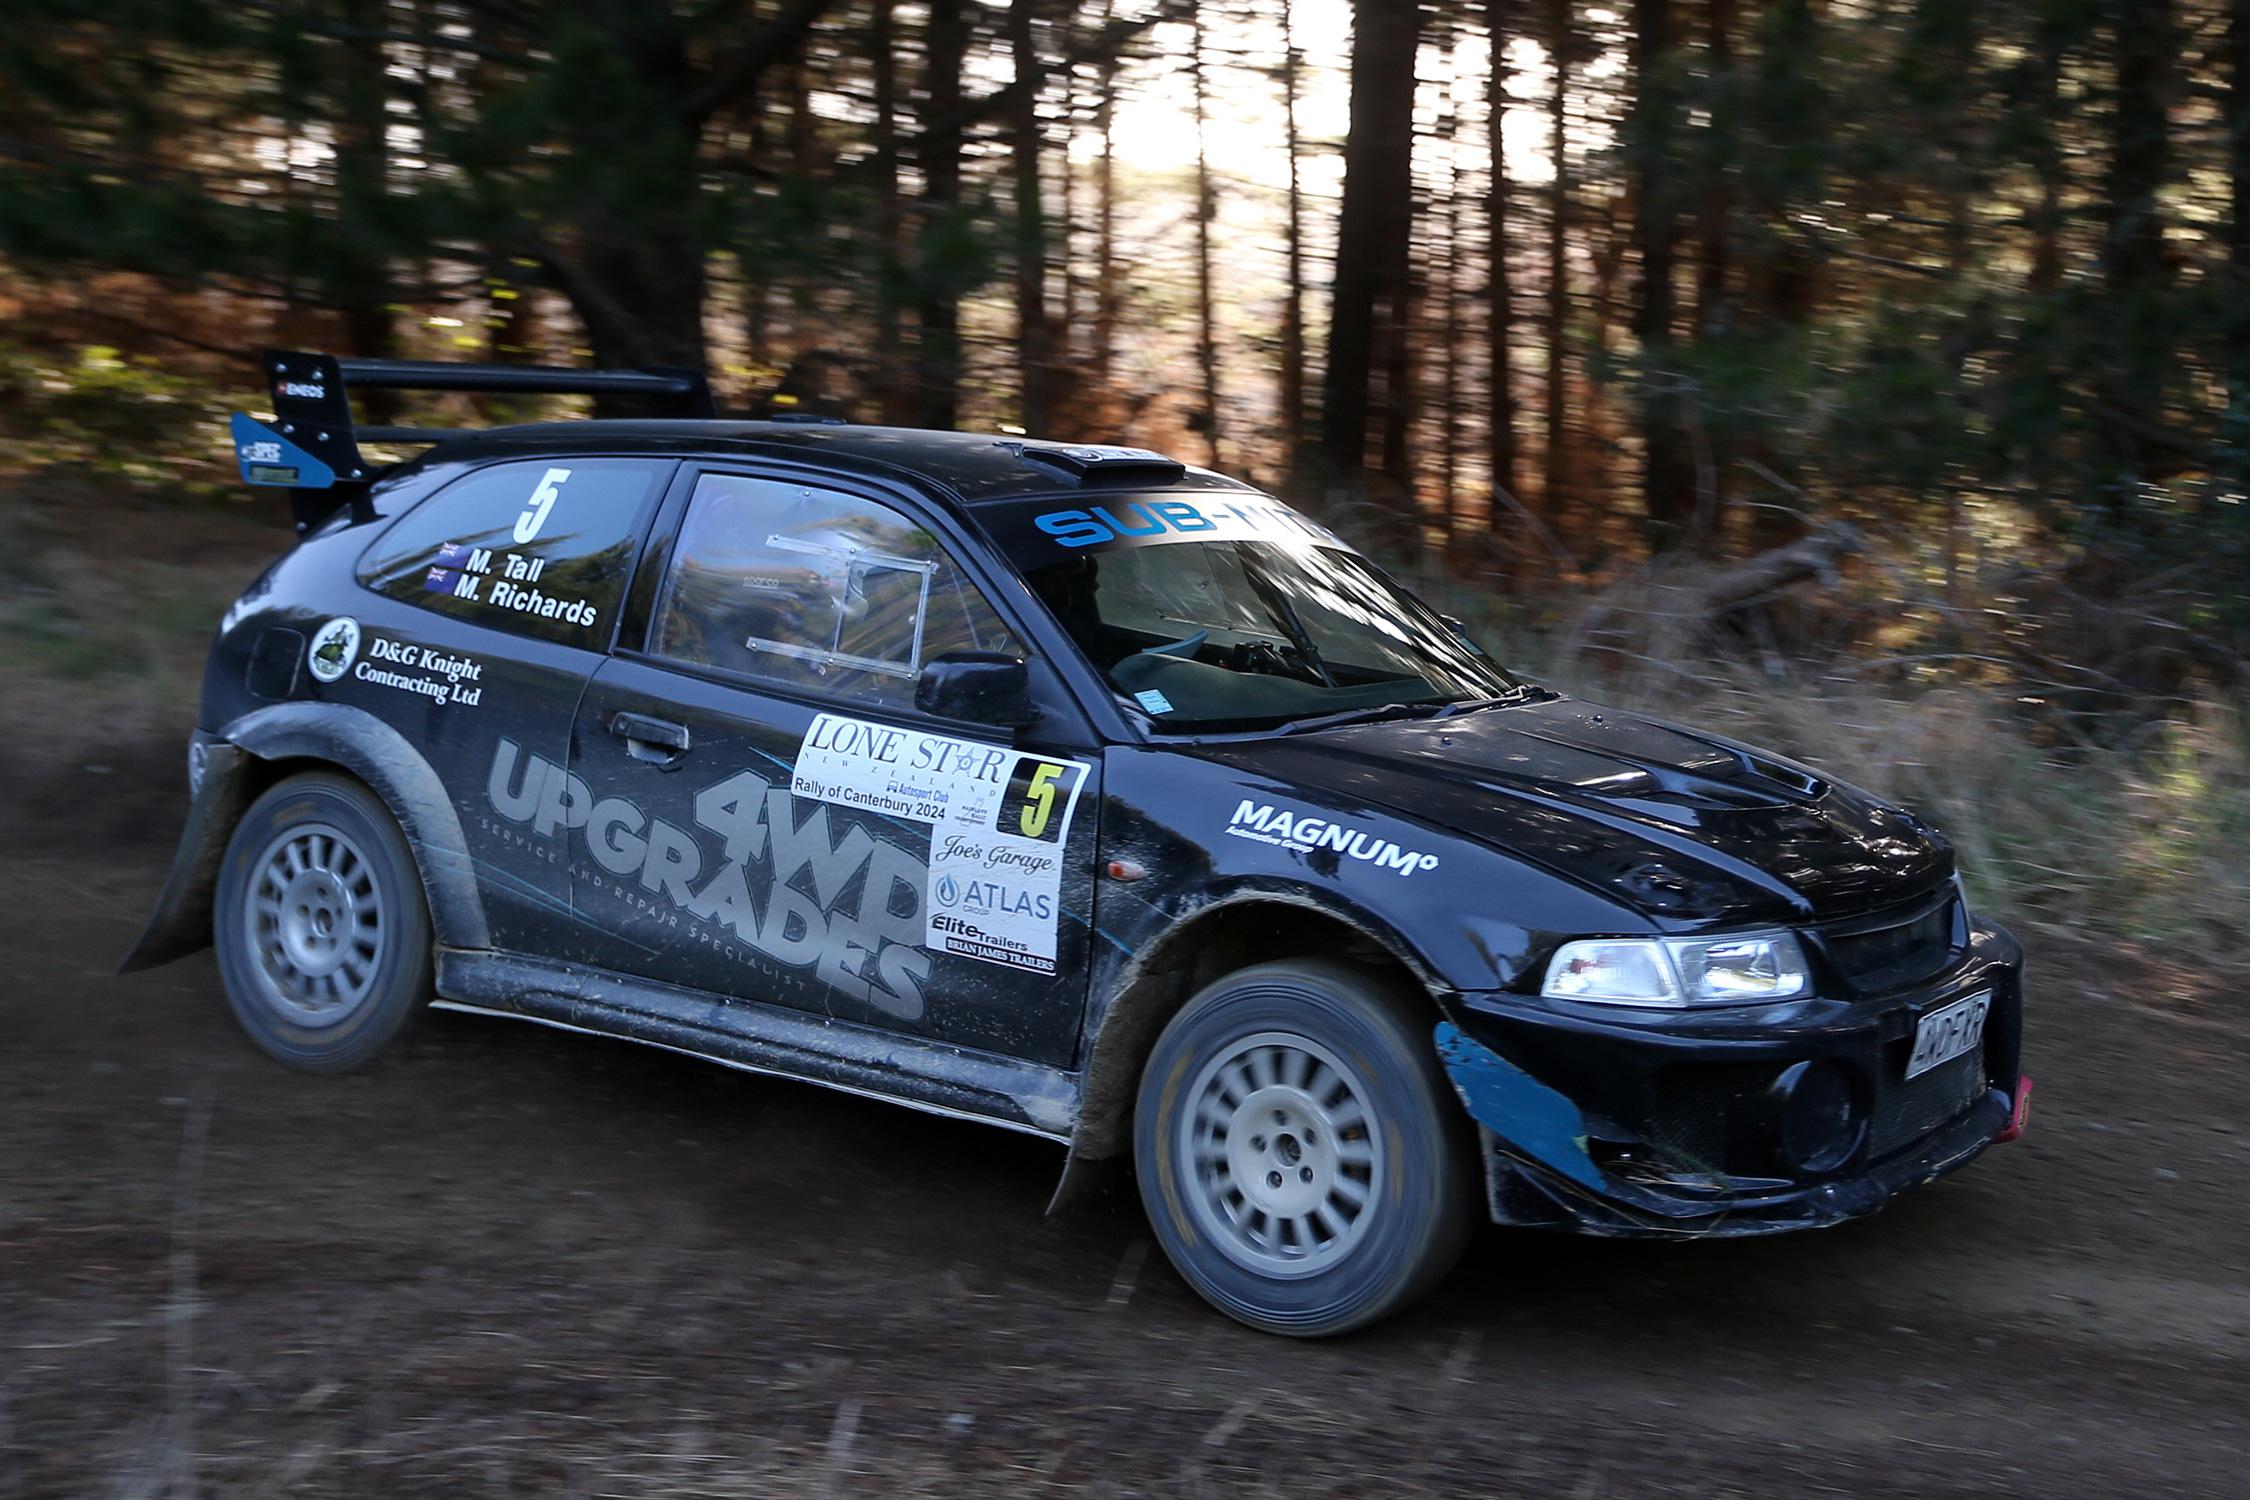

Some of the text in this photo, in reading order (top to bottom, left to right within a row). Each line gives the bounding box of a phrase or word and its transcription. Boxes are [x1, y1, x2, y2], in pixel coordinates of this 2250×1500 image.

[512, 467, 573, 544] 5
[465, 548, 545, 582] M. Tall
[453, 574, 597, 627] M. Richards
[370, 637, 483, 683] D&G Knight
[355, 661, 482, 706] Contracting Ltd
[808, 717, 907, 764] LONE
[795, 777, 946, 820] Rally of Canterbury 2024
[1019, 763, 1065, 838] 5
[694, 768, 930, 948] 4WD
[935, 835, 1053, 876] Joe's Garage
[480, 818, 806, 992] SERVICE AND REPAIR SPECIALIST
[964, 881, 1050, 920] ATLAS
[947, 939, 1056, 971] BRIAN JAMES TRAILERS
